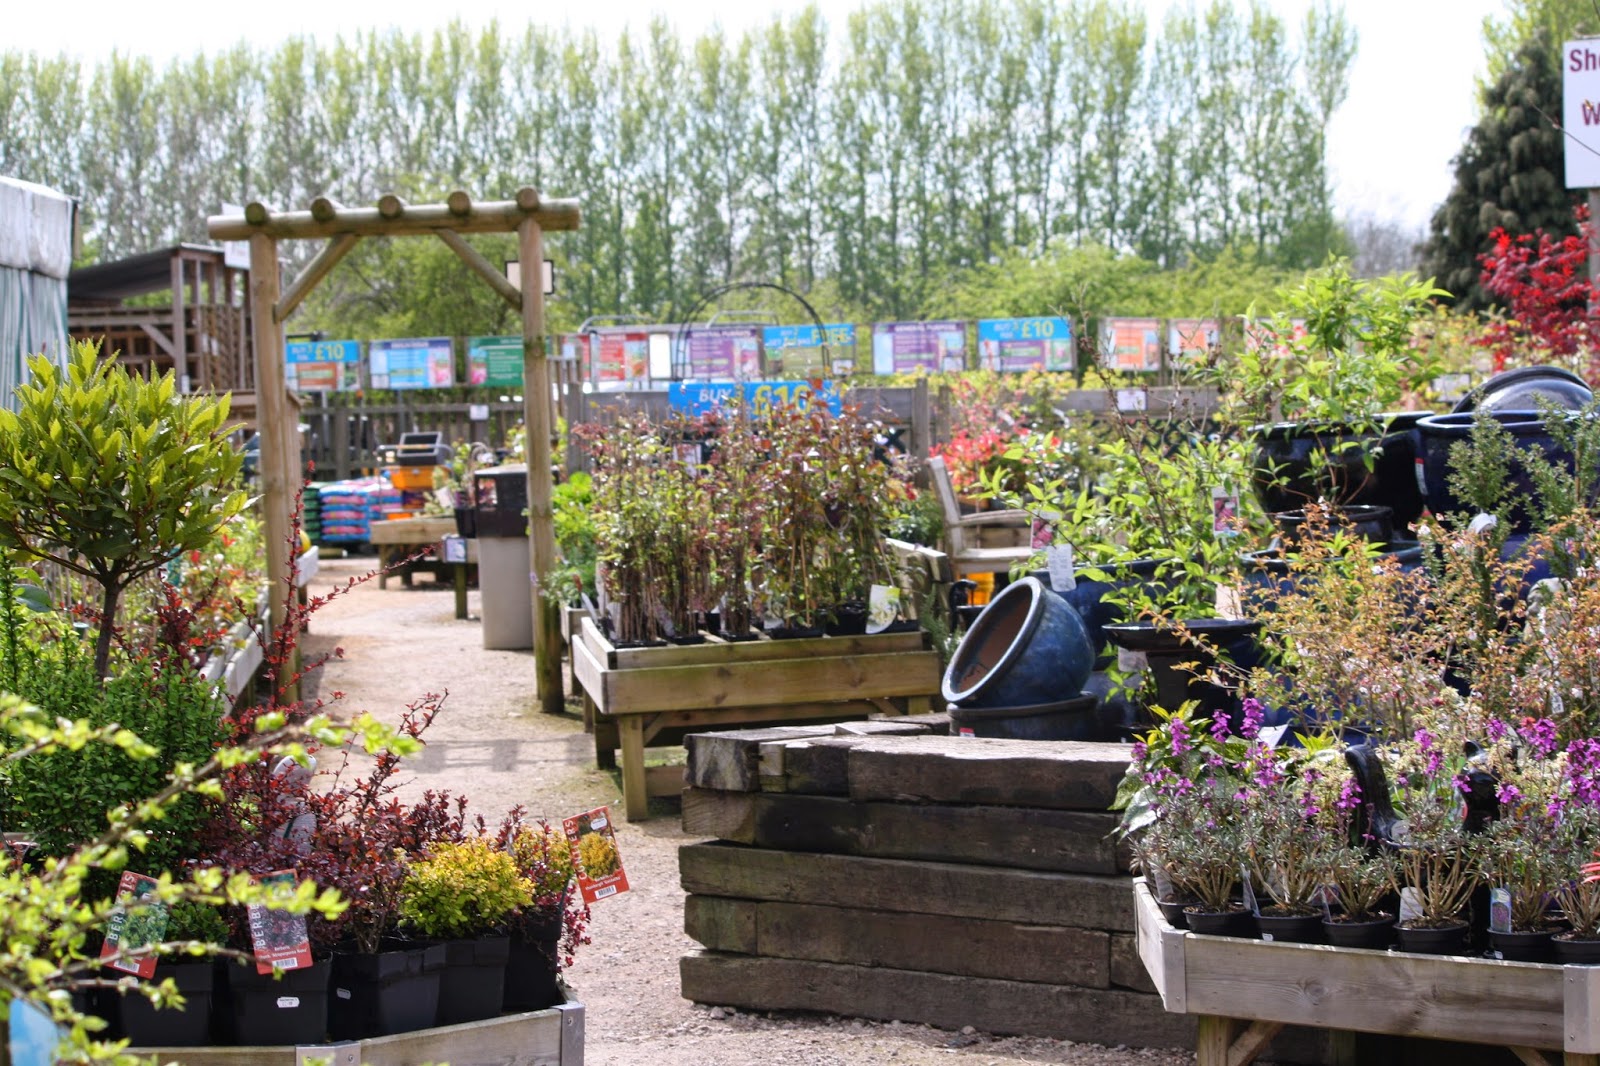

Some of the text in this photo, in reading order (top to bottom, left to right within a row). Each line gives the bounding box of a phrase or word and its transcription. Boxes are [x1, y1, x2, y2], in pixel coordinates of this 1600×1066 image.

[1569, 49, 1600, 72] Sh
[1021, 320, 1054, 339] £10
[315, 343, 345, 361] £10
[698, 388, 732, 403] BUY
[752, 384, 812, 417] £10
